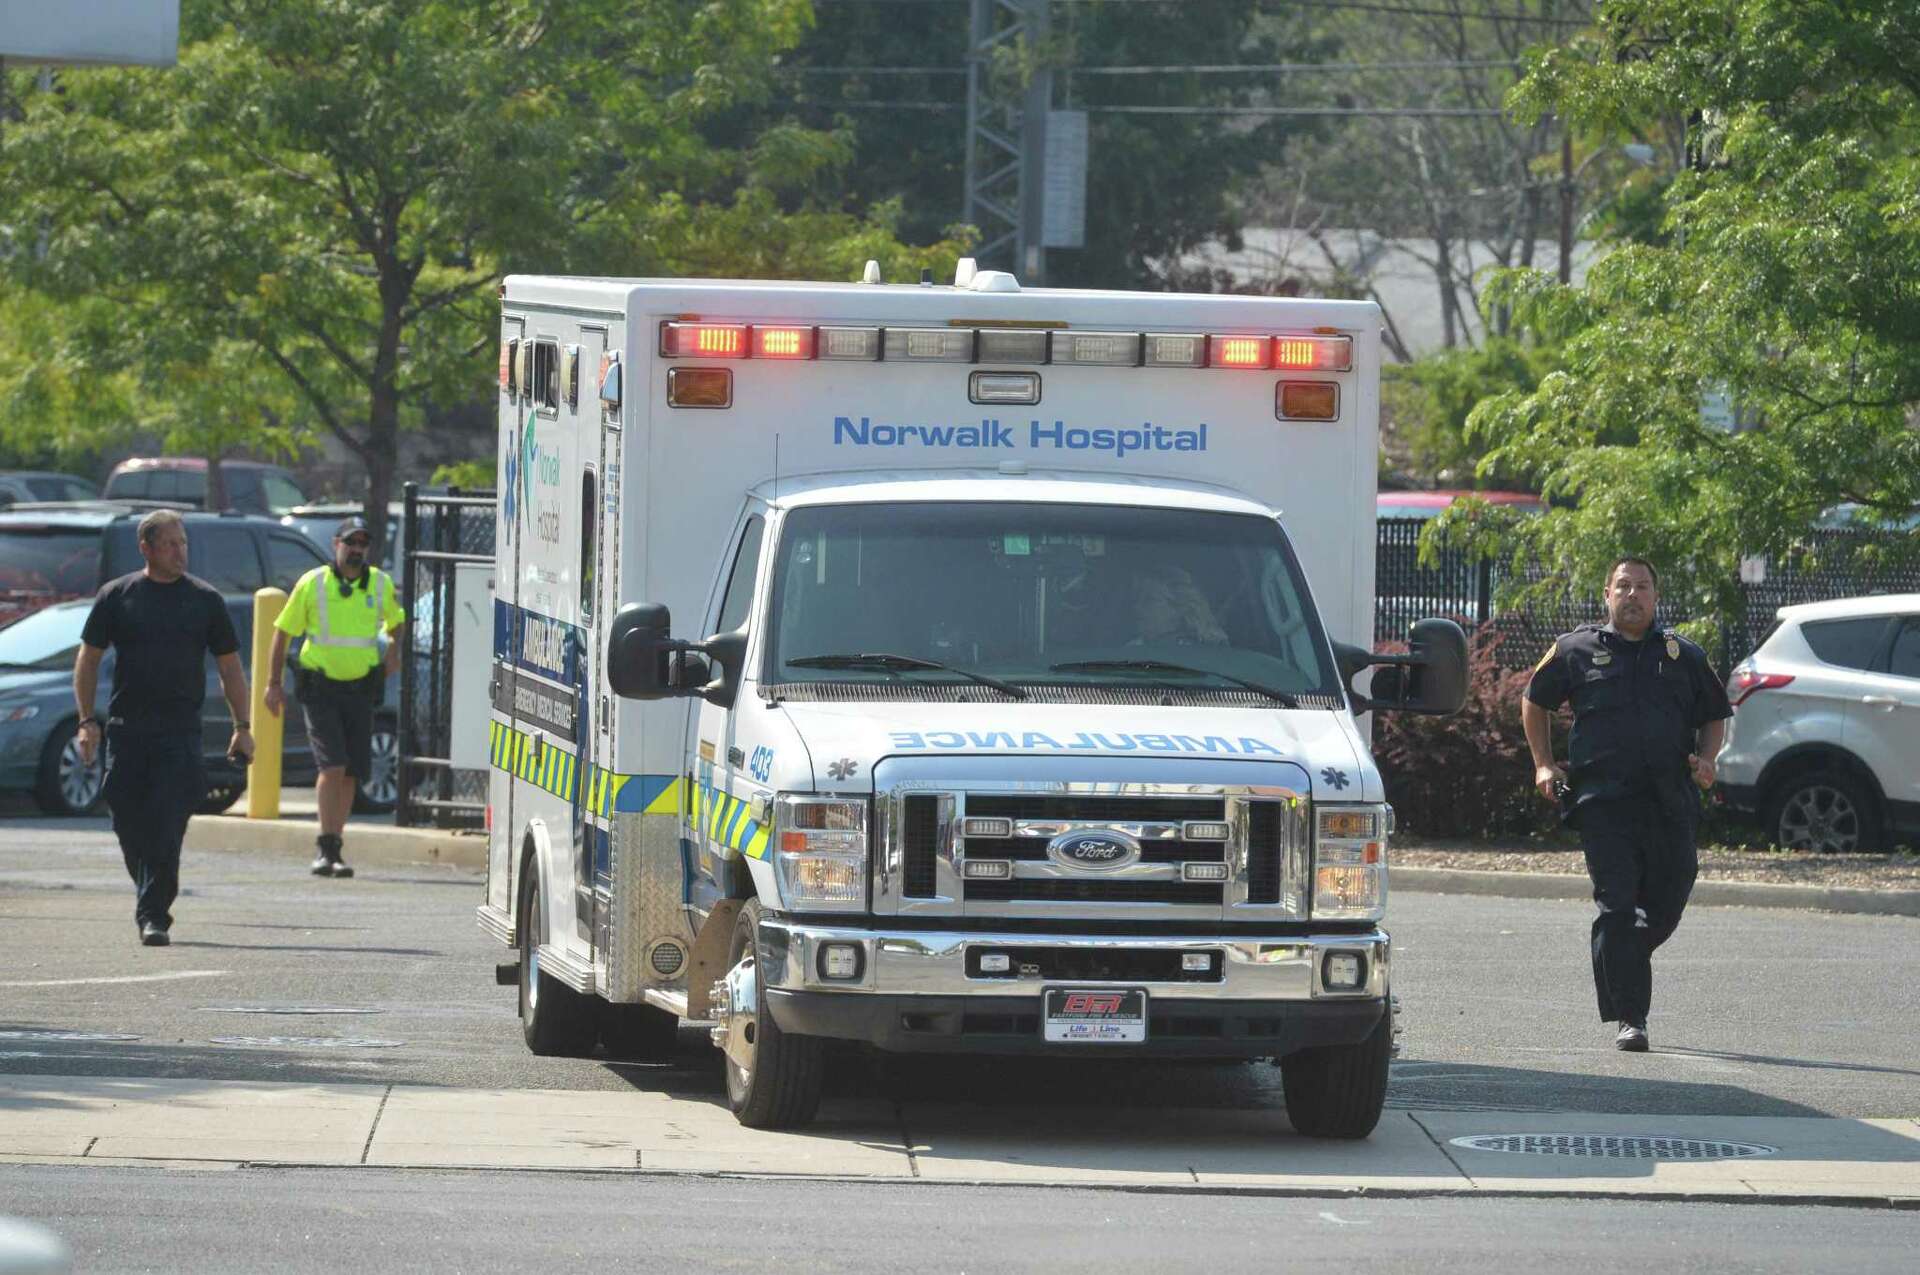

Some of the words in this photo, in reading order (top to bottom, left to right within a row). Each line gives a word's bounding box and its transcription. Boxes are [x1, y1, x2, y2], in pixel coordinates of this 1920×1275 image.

[834, 417, 1014, 448] Norwalk
[1031, 421, 1207, 457] Hospital
[523, 616, 566, 674] AMBULANCE
[750, 744, 774, 783] 403
[1074, 840, 1117, 858] Ford
